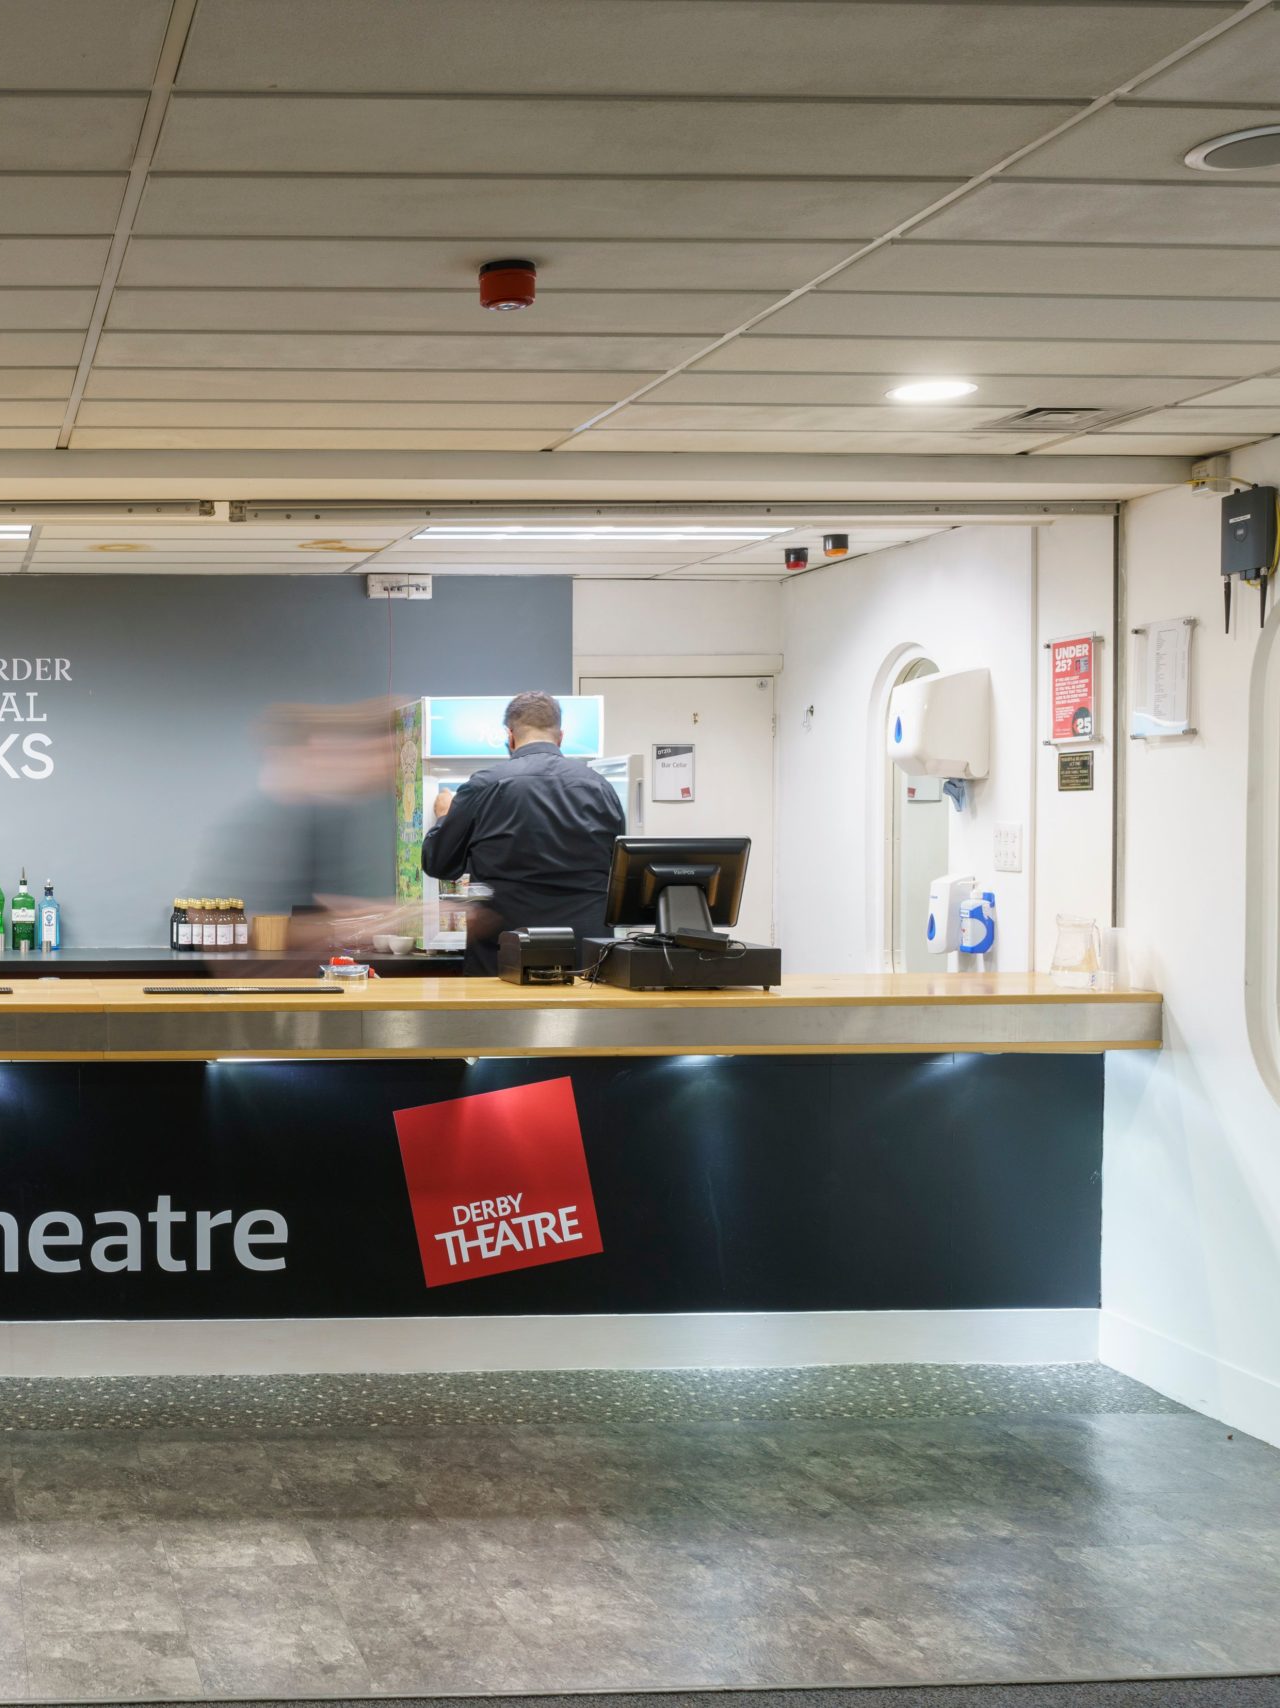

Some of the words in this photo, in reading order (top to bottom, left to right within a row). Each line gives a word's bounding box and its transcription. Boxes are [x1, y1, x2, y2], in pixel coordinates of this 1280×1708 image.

[1055, 644, 1089, 660] UNDER
[1055, 659, 1072, 673] 25?
[1076, 717, 1092, 735] 25
[452, 1192, 523, 1226] DERBY
[434, 1205, 584, 1266] THEATRE
